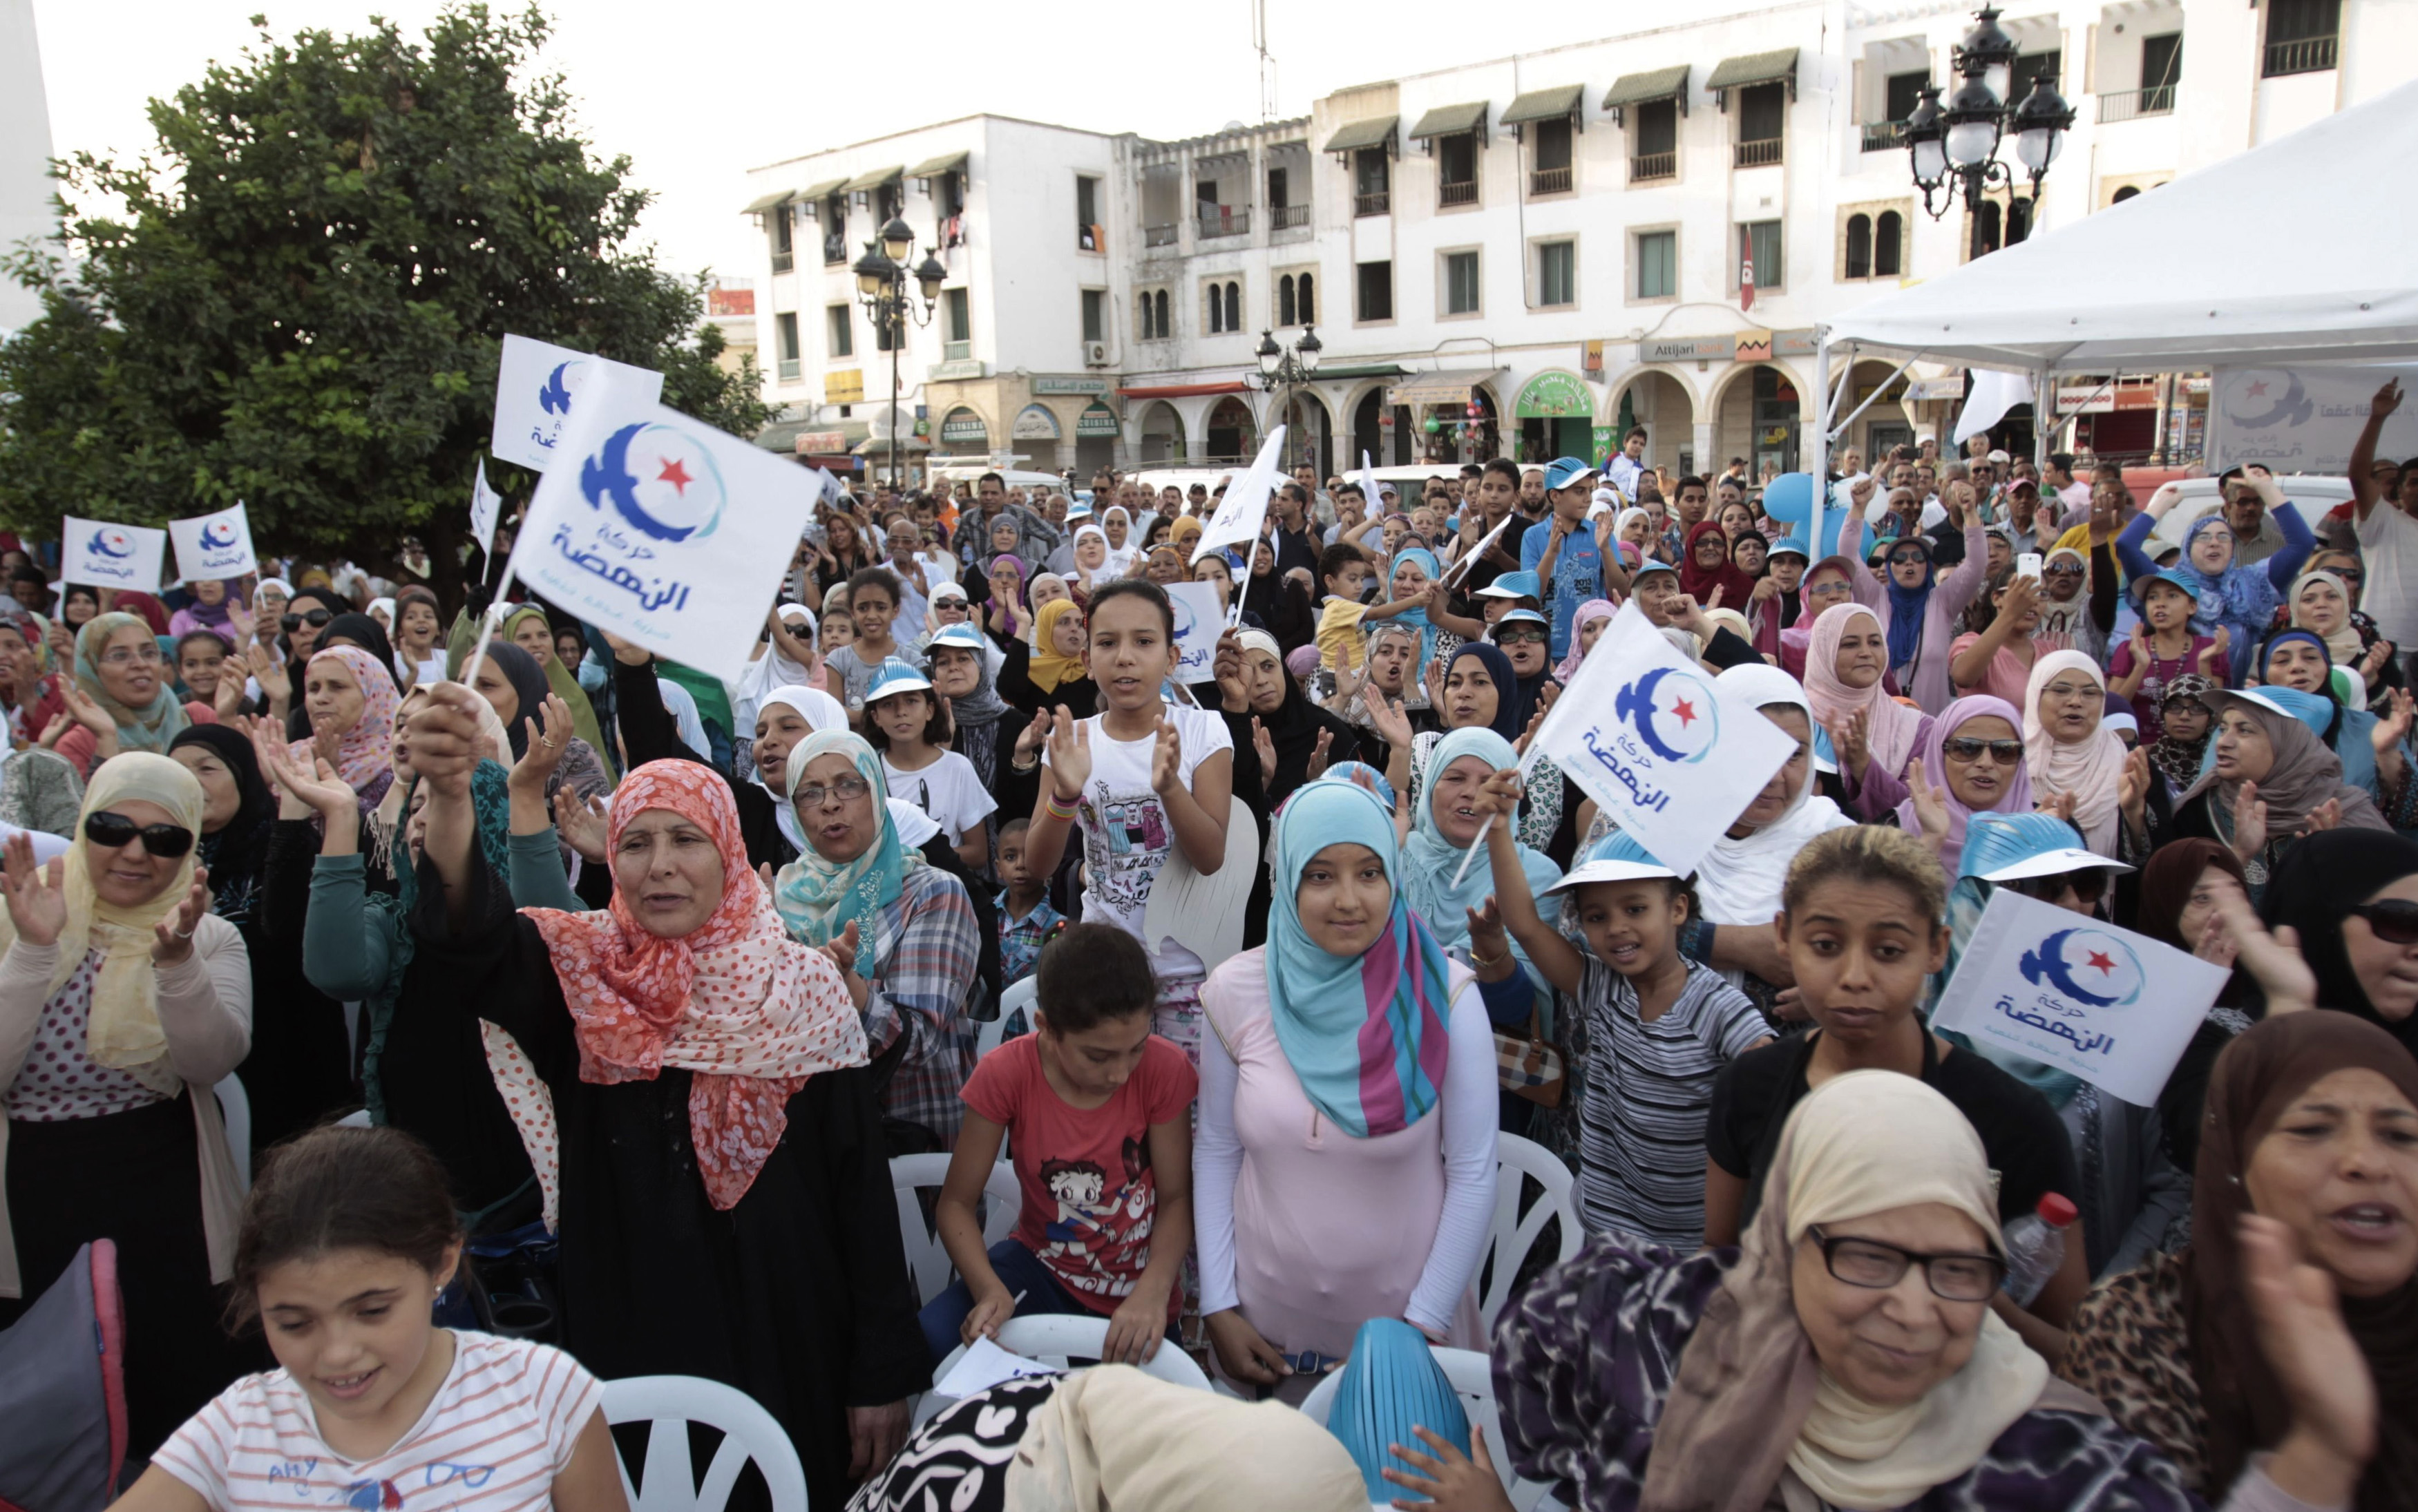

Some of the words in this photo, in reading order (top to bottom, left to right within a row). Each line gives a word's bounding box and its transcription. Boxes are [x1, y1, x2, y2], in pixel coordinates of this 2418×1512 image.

[1655, 344, 1693, 357] Attijari
[1697, 343, 1724, 354] bank
[944, 421, 983, 431] CUISINE
[1078, 419, 1115, 427] CUISINE
[597, 522, 656, 559] حركة
[551, 522, 691, 611] النهضة
[1177, 649, 1209, 667] النه
[1617, 733, 1652, 769] حركة
[1582, 725, 1670, 813] النهضة
[2037, 993, 2086, 1017] حركة
[1995, 995, 2115, 1055] النهضة
